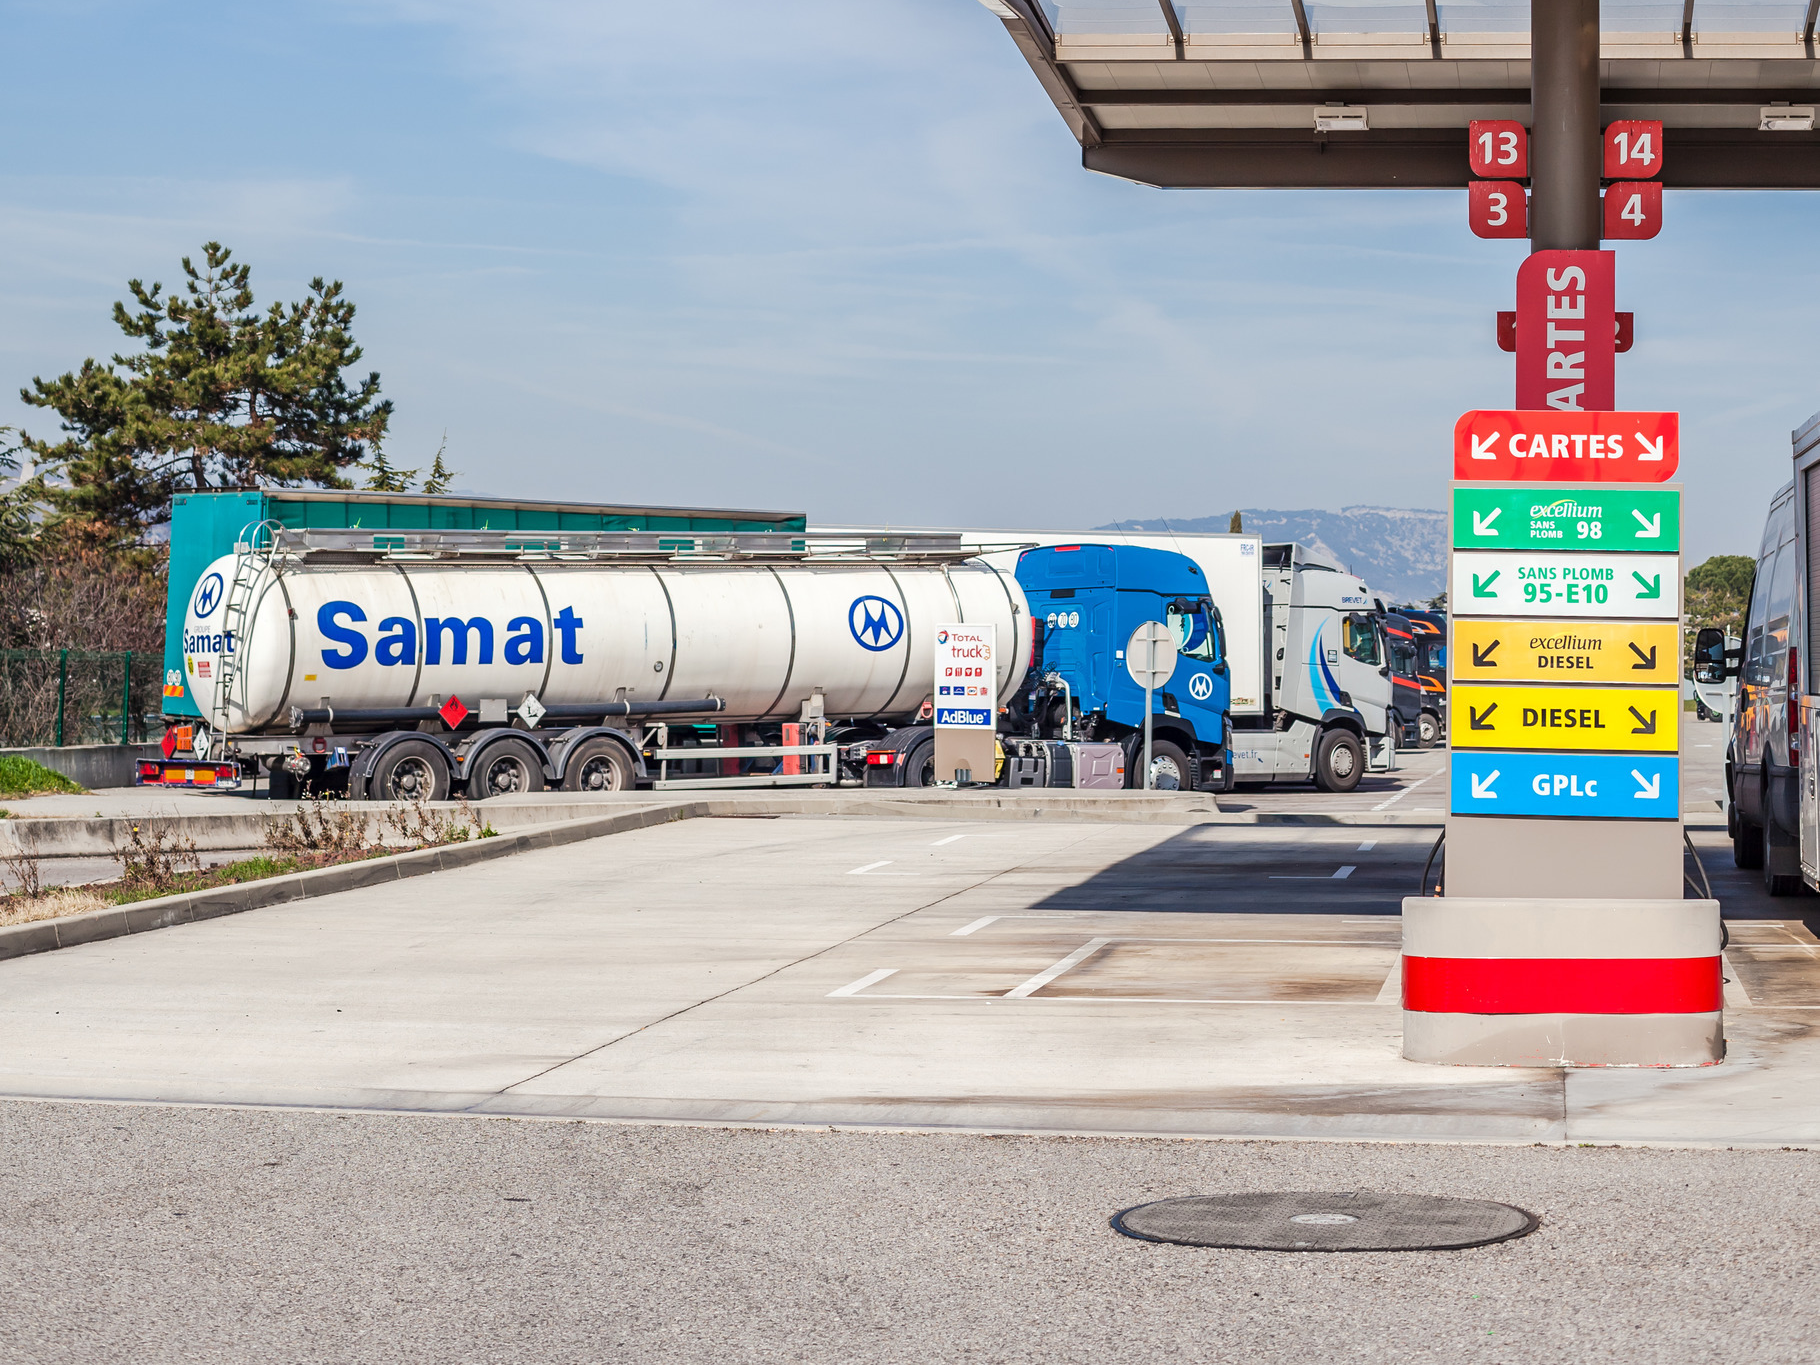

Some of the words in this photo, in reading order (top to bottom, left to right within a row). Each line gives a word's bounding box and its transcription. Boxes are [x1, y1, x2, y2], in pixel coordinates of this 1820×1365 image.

[1478, 131, 1518, 165] 13
[1613, 132, 1656, 166] 14
[1487, 192, 1508, 227] 3
[1620, 193, 1646, 227] 4
[1546, 265, 1586, 411] ARTES
[1508, 433, 1624, 459] CARTES
[1530, 502, 1602, 518] excellium
[1530, 520, 1556, 529] SANS
[1530, 530, 1563, 539] PLOMB
[1576, 520, 1602, 540] 98
[1518, 566, 1557, 580] SANS
[1563, 567, 1614, 581] PLOMB
[1523, 582, 1608, 604] 95-E10
[184, 628, 235, 654] Samat
[317, 600, 584, 670] Samat
[951, 633, 983, 642] TOTAL
[1530, 635, 1602, 651] excellium
[951, 644, 983, 658] truck
[1537, 655, 1594, 669] DIESEL
[1522, 708, 1606, 729] DIESEL
[1532, 773, 1598, 797] GPLc
